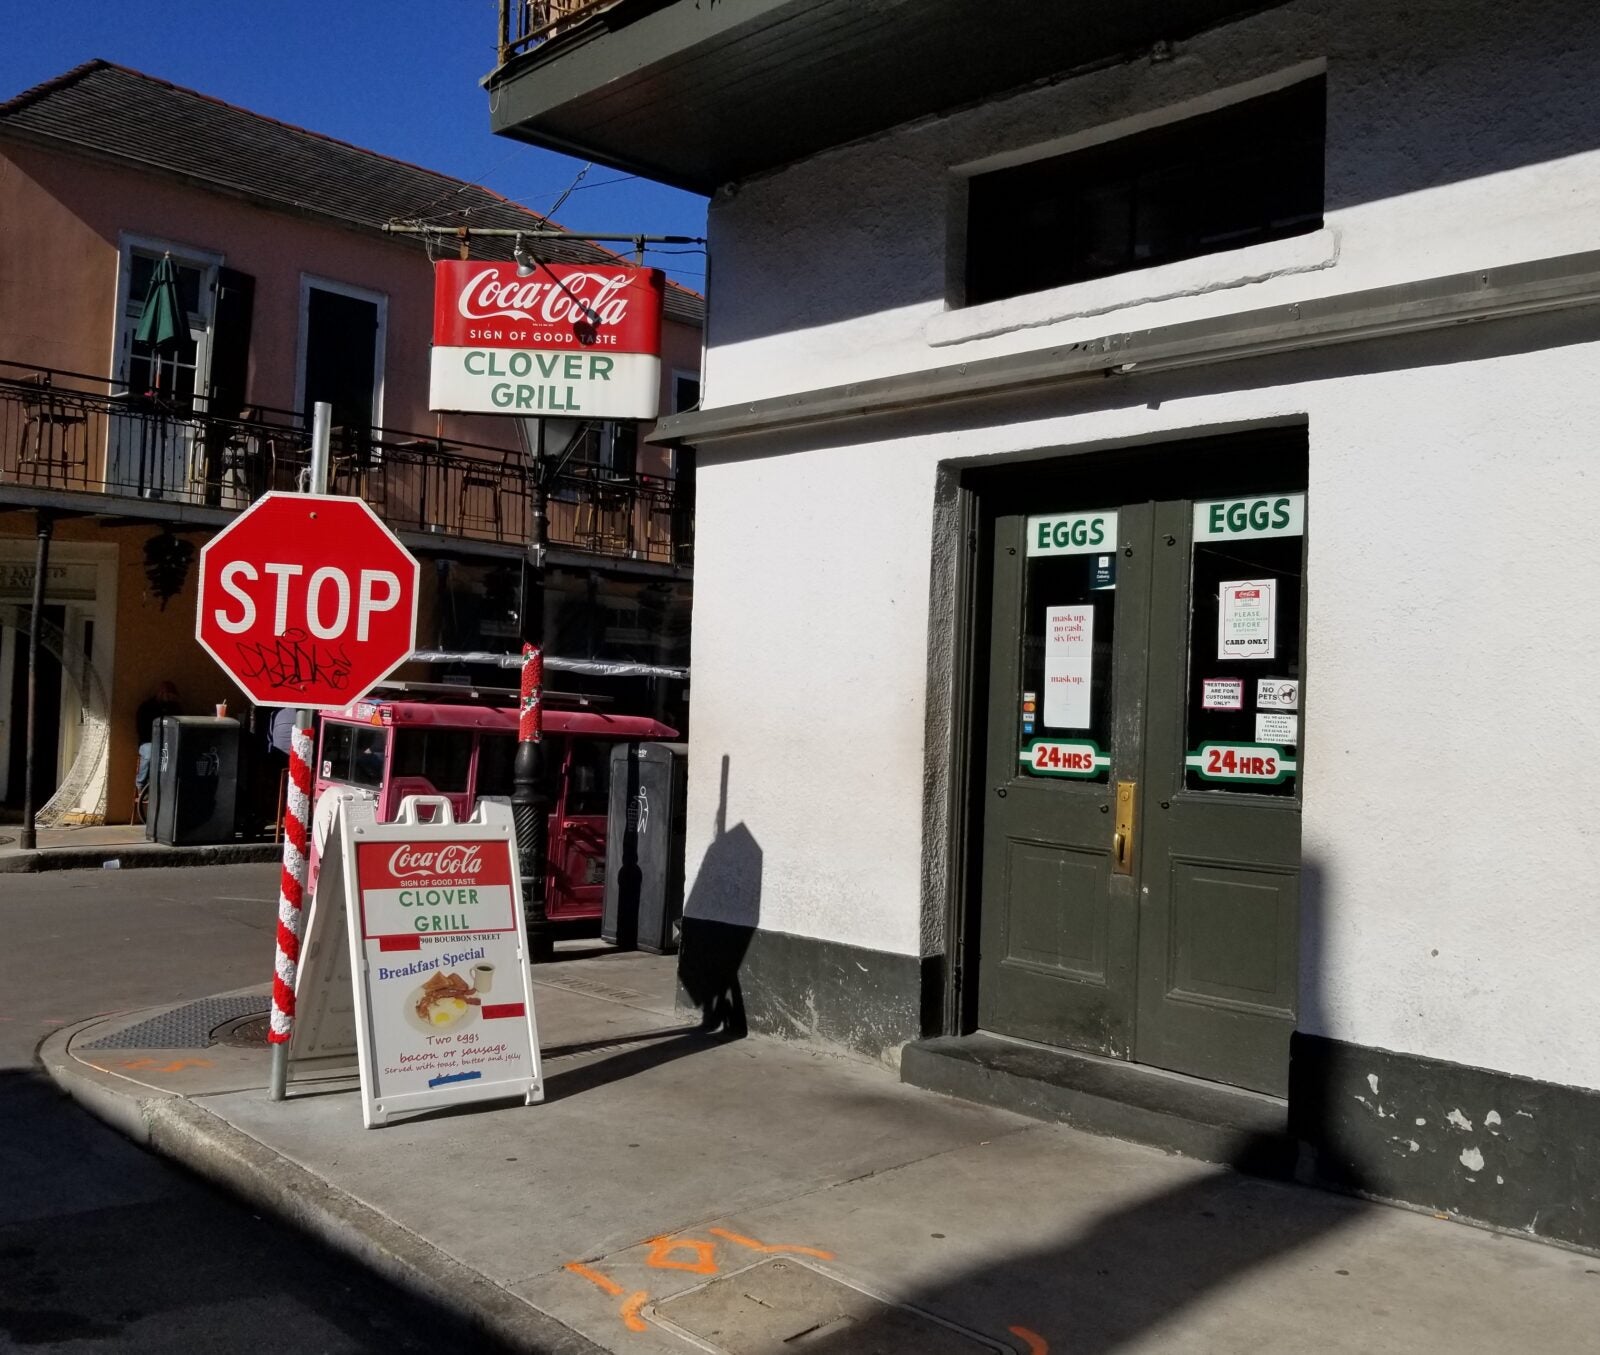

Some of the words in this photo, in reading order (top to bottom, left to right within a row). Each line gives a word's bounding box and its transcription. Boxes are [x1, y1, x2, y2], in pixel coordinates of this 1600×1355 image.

[458, 268, 639, 326] Coca-Cola
[470, 329, 503, 340] SIGN
[509, 330, 527, 341] OF
[533, 332, 573, 343] GOOD
[580, 334, 617, 345] TASTE
[463, 351, 614, 381] CLOVER
[491, 383, 581, 410] GRILL
[1208, 498, 1291, 534] EGGS
[1037, 518, 1105, 549] EGGS
[214, 560, 401, 642] STOP
[1052, 614, 1072, 622] mask
[1054, 634, 1064, 642] six
[1051, 675, 1072, 683] mask
[388, 844, 482, 878] Coca-Cola
[431, 878, 453, 886] GOOD
[399, 889, 479, 907] CLOVER
[414, 914, 469, 932] GRILL
[434, 935, 472, 943] BOURBON
[473, 933, 501, 941] STREET
[379, 956, 440, 980] Breakfast
[442, 947, 485, 967] Special
[426, 1035, 452, 1045] Two
[457, 1033, 480, 1044] eggs
[400, 1052, 439, 1063] bacon
[443, 1049, 457, 1058] or
[461, 1043, 507, 1057] sausage
[384, 1064, 413, 1075] Served
[416, 1062, 435, 1072] with
[462, 1056, 484, 1066] butter
[505, 1053, 521, 1063] jelly
